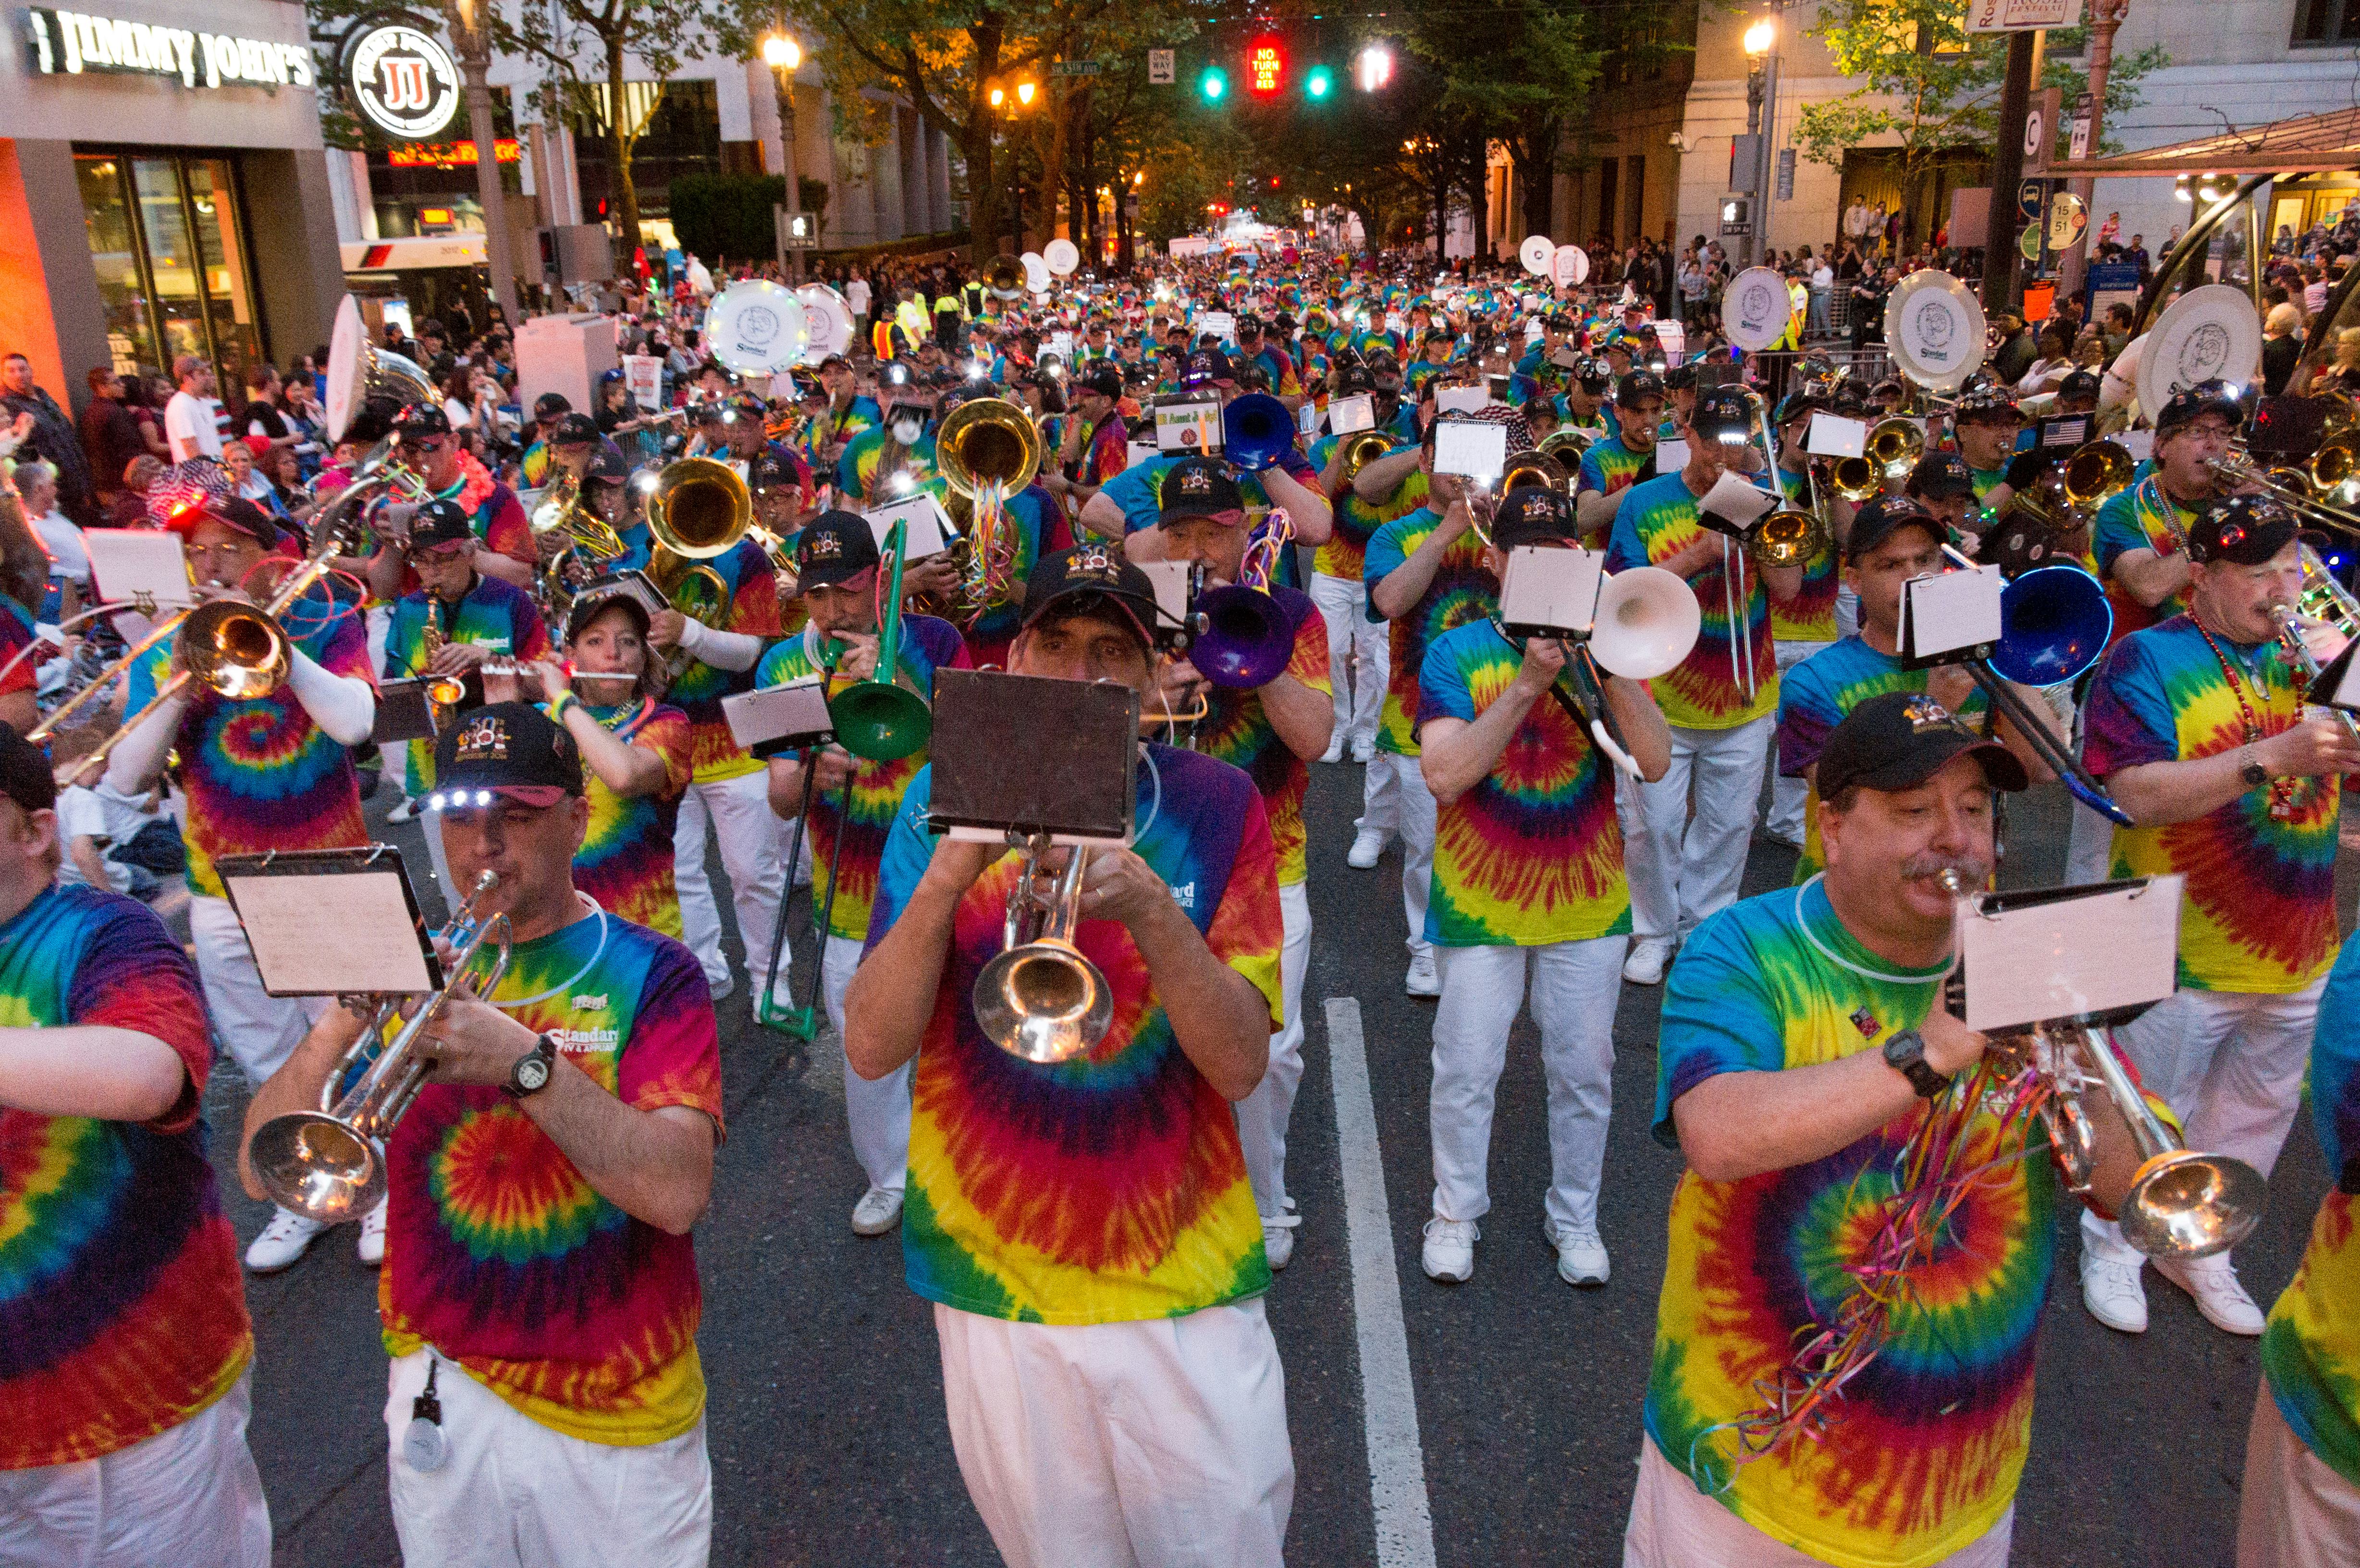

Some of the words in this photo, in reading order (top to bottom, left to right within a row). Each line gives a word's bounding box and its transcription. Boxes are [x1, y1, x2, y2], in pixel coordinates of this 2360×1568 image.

[56, 10, 195, 88] JIMMY
[198, 32, 312, 88] JOHN'S
[1153, 51, 1169, 61] ONE
[1257, 49, 1274, 60] NO
[1153, 61, 1170, 70] WAY
[1253, 60, 1279, 71] TURN
[1258, 71, 1272, 79] ON
[1256, 79, 1275, 89] RED
[2056, 206, 2069, 215] 15
[2054, 221, 2067, 232] 51
[545, 1026, 618, 1051] Standar
